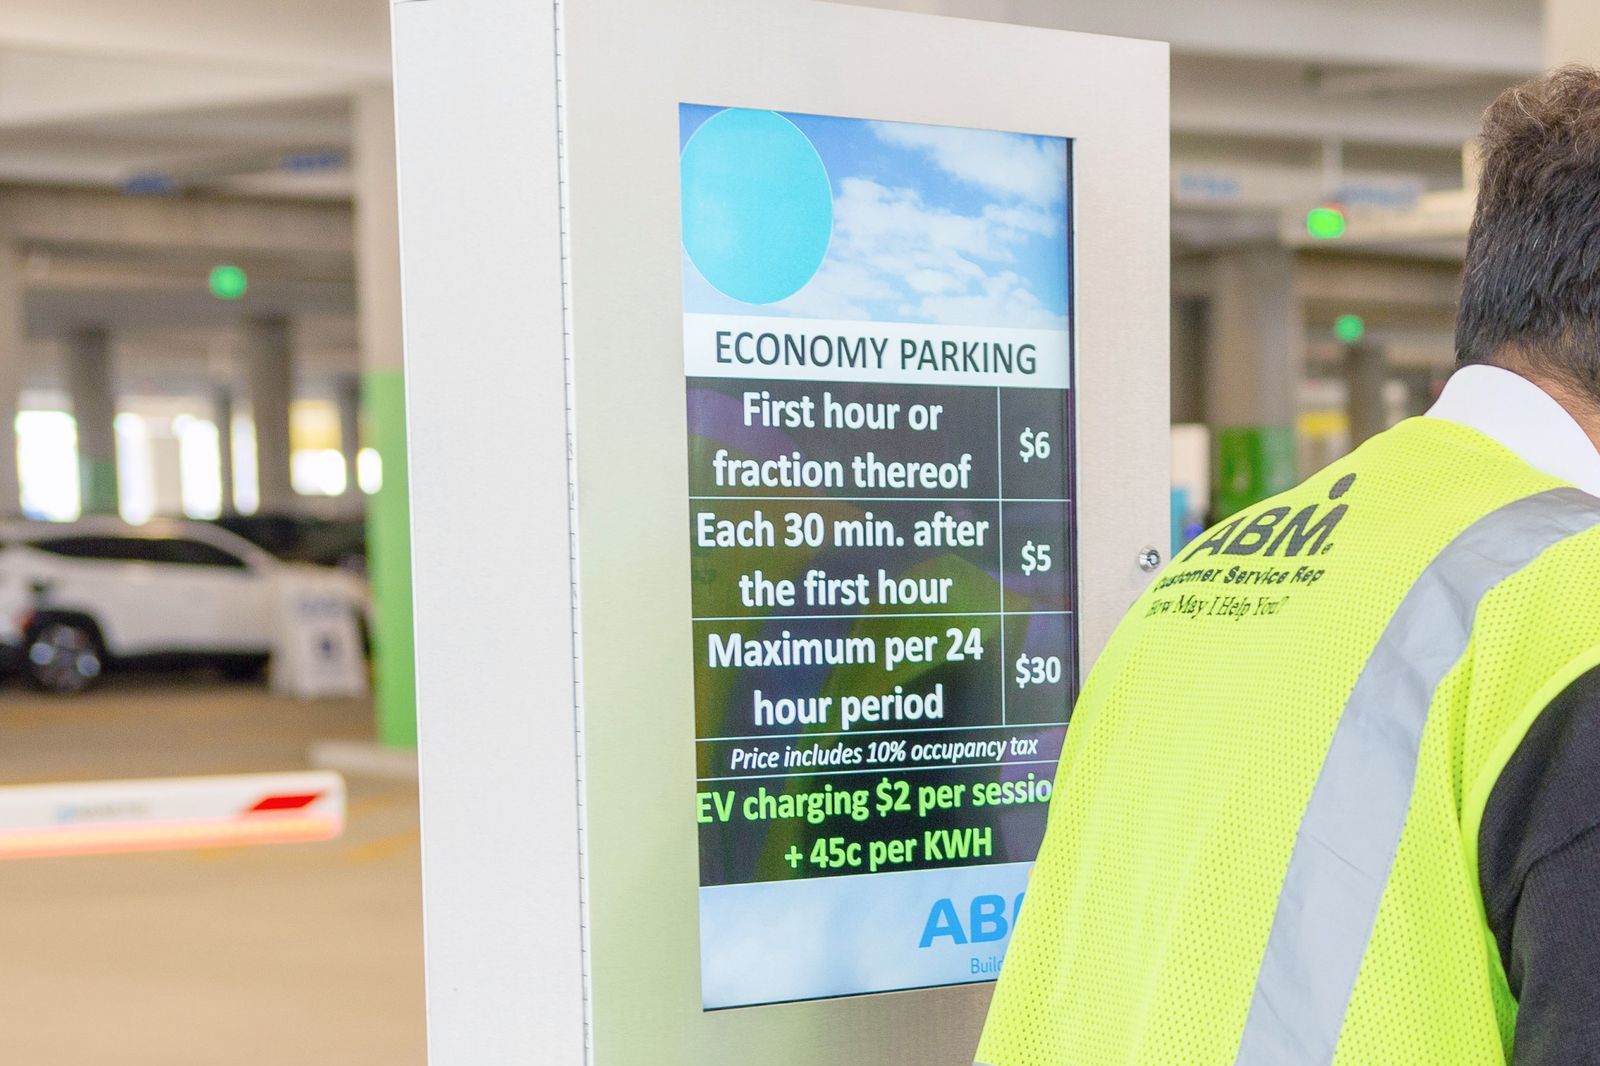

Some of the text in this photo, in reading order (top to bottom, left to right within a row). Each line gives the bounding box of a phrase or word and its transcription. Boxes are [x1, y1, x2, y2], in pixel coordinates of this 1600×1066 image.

[716, 331, 1036, 374] ECONOMY PARKING
[743, 391, 943, 430] First hour or
[1019, 427, 1050, 462] $6
[712, 450, 972, 488] fraction thereof
[697, 511, 989, 547] Each 30 min. after
[1181, 502, 1349, 562] ABM
[1021, 540, 1051, 576] $5
[1223, 565, 1290, 584] Service
[1290, 566, 1326, 586] Rep
[738, 569, 953, 606] the first hour
[1173, 594, 1208, 619] May
[1215, 596, 1252, 621] Help
[708, 627, 984, 671] Maximum per 24
[1015, 653, 1061, 688] $30
[753, 684, 943, 729] hour period
[730, 737, 1038, 769] Price includes 10% occupancy tax
[696, 792, 735, 824] EV
[742, 785, 869, 823] charging
[876, 777, 911, 816] $2
[918, 784, 966, 816] per
[810, 837, 862, 868] 45c
[869, 839, 917, 871] per
[924, 827, 992, 860] KWH
